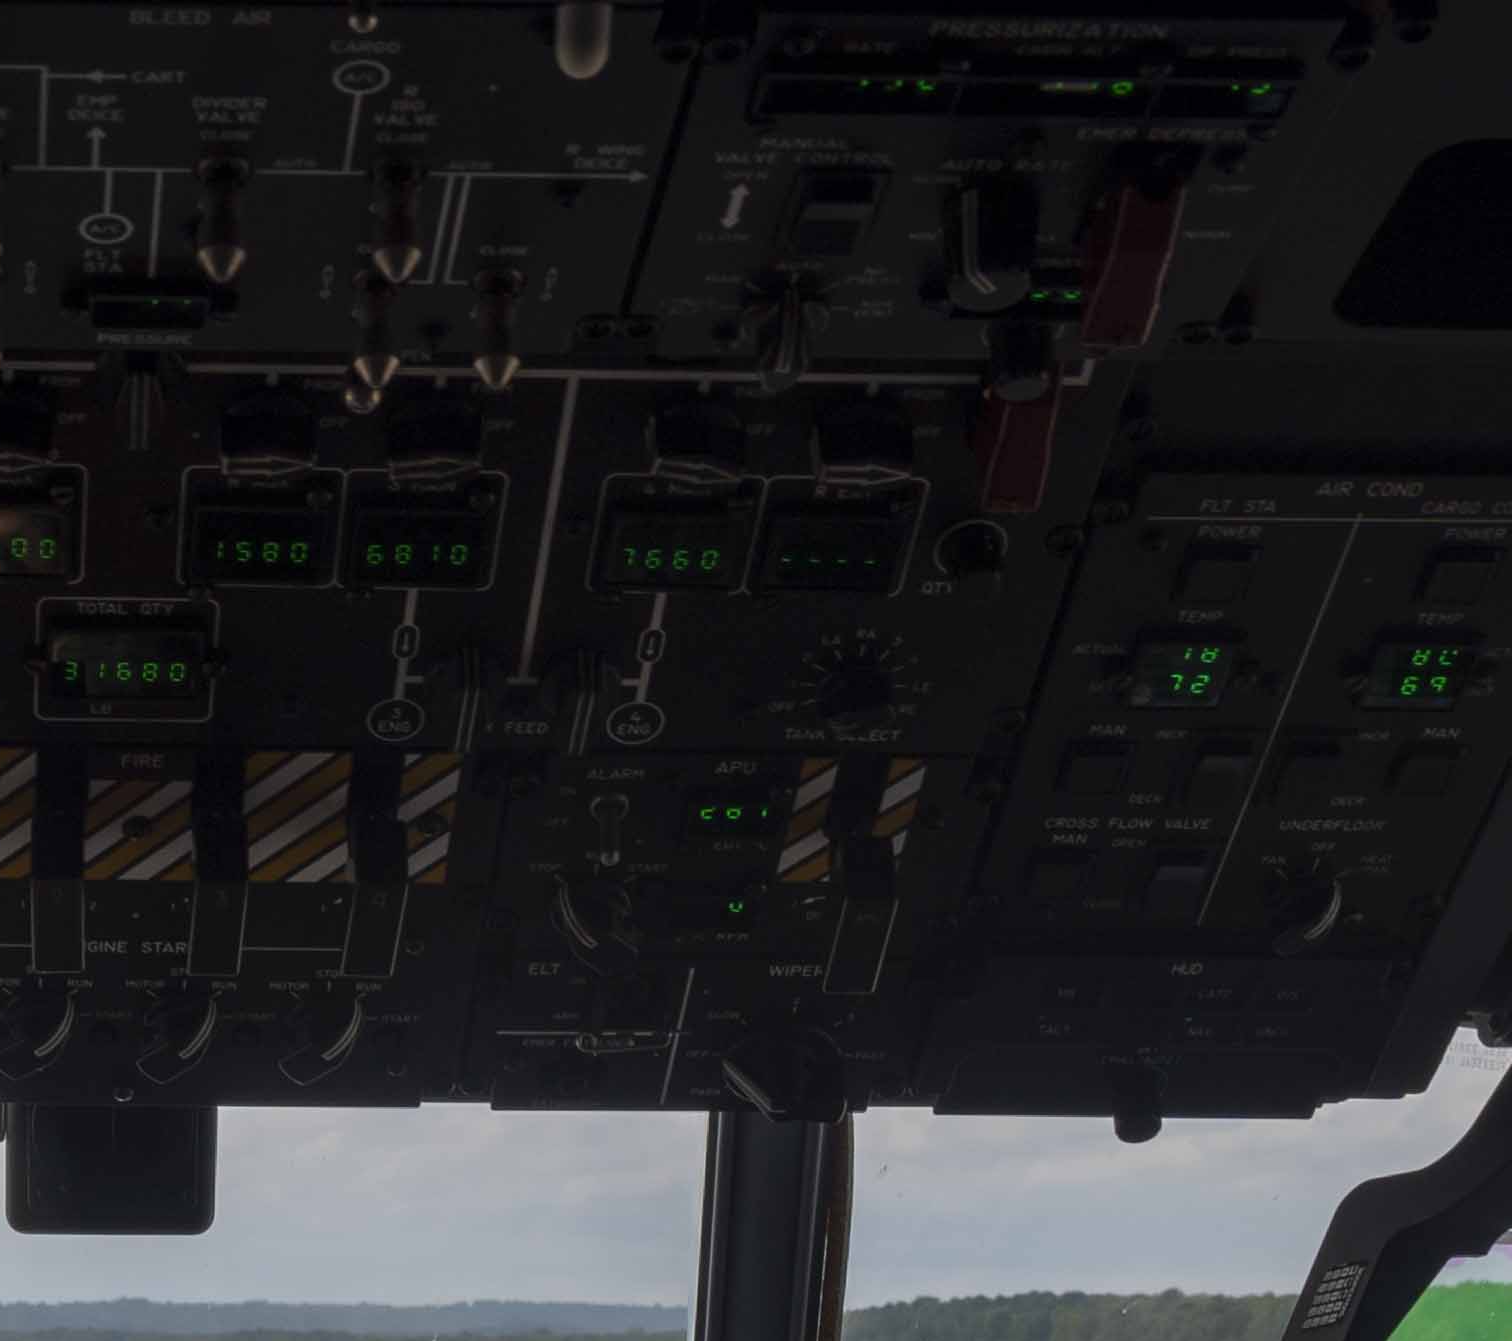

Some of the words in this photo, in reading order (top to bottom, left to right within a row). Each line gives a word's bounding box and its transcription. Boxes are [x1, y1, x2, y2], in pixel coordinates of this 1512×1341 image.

[129, 9, 210, 26] BLEED
[233, 10, 271, 26] AIR
[929, 21, 1169, 39] PRESSURIZATION
[132, 70, 185, 84] CART
[1317, 481, 1353, 496] AIR
[1367, 482, 1423, 497] COND
[1200, 500, 1231, 514] FLT
[1242, 501, 1276, 514] STA
[1422, 501, 1481, 515] CARGO
[215, 542, 309, 563] 1580
[367, 544, 469, 565] 6810
[623, 547, 721, 570] 7660
[78, 602, 128, 615] TOTAL
[140, 602, 175, 616] QTY
[1178, 610, 1223, 624] TEMP
[1418, 612, 1463, 626] TEMP
[64, 662, 187, 682] 31680
[377, 719, 411, 733] ENG
[504, 721, 549, 735] FEED
[616, 722, 651, 736] ENG
[121, 754, 165, 769] FIRE
[715, 760, 757, 775] APU
[587, 768, 645, 780] ALARM
